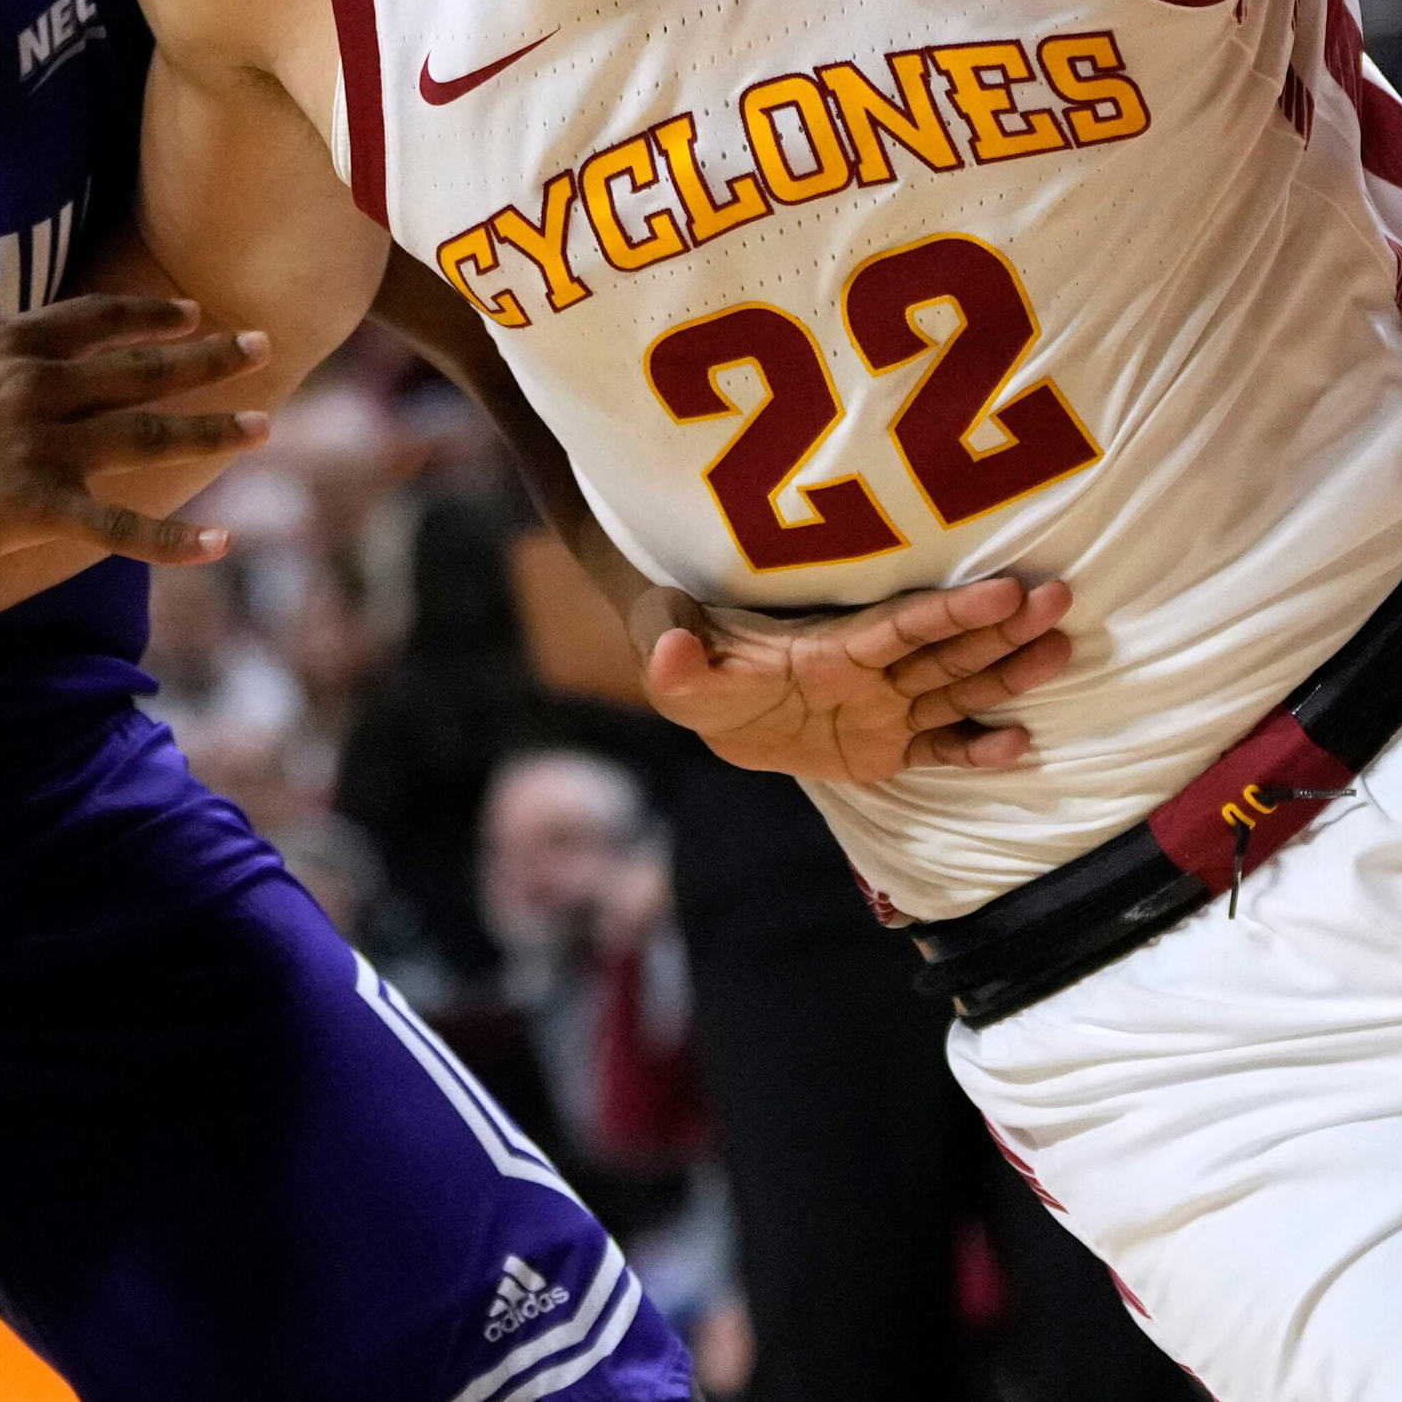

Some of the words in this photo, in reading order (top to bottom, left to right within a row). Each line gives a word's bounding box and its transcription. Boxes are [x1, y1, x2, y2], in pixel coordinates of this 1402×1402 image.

[437, 32, 1150, 327] CYCLONES
[644, 232, 1103, 574] 22
[486, 1287, 569, 1341] adidas
